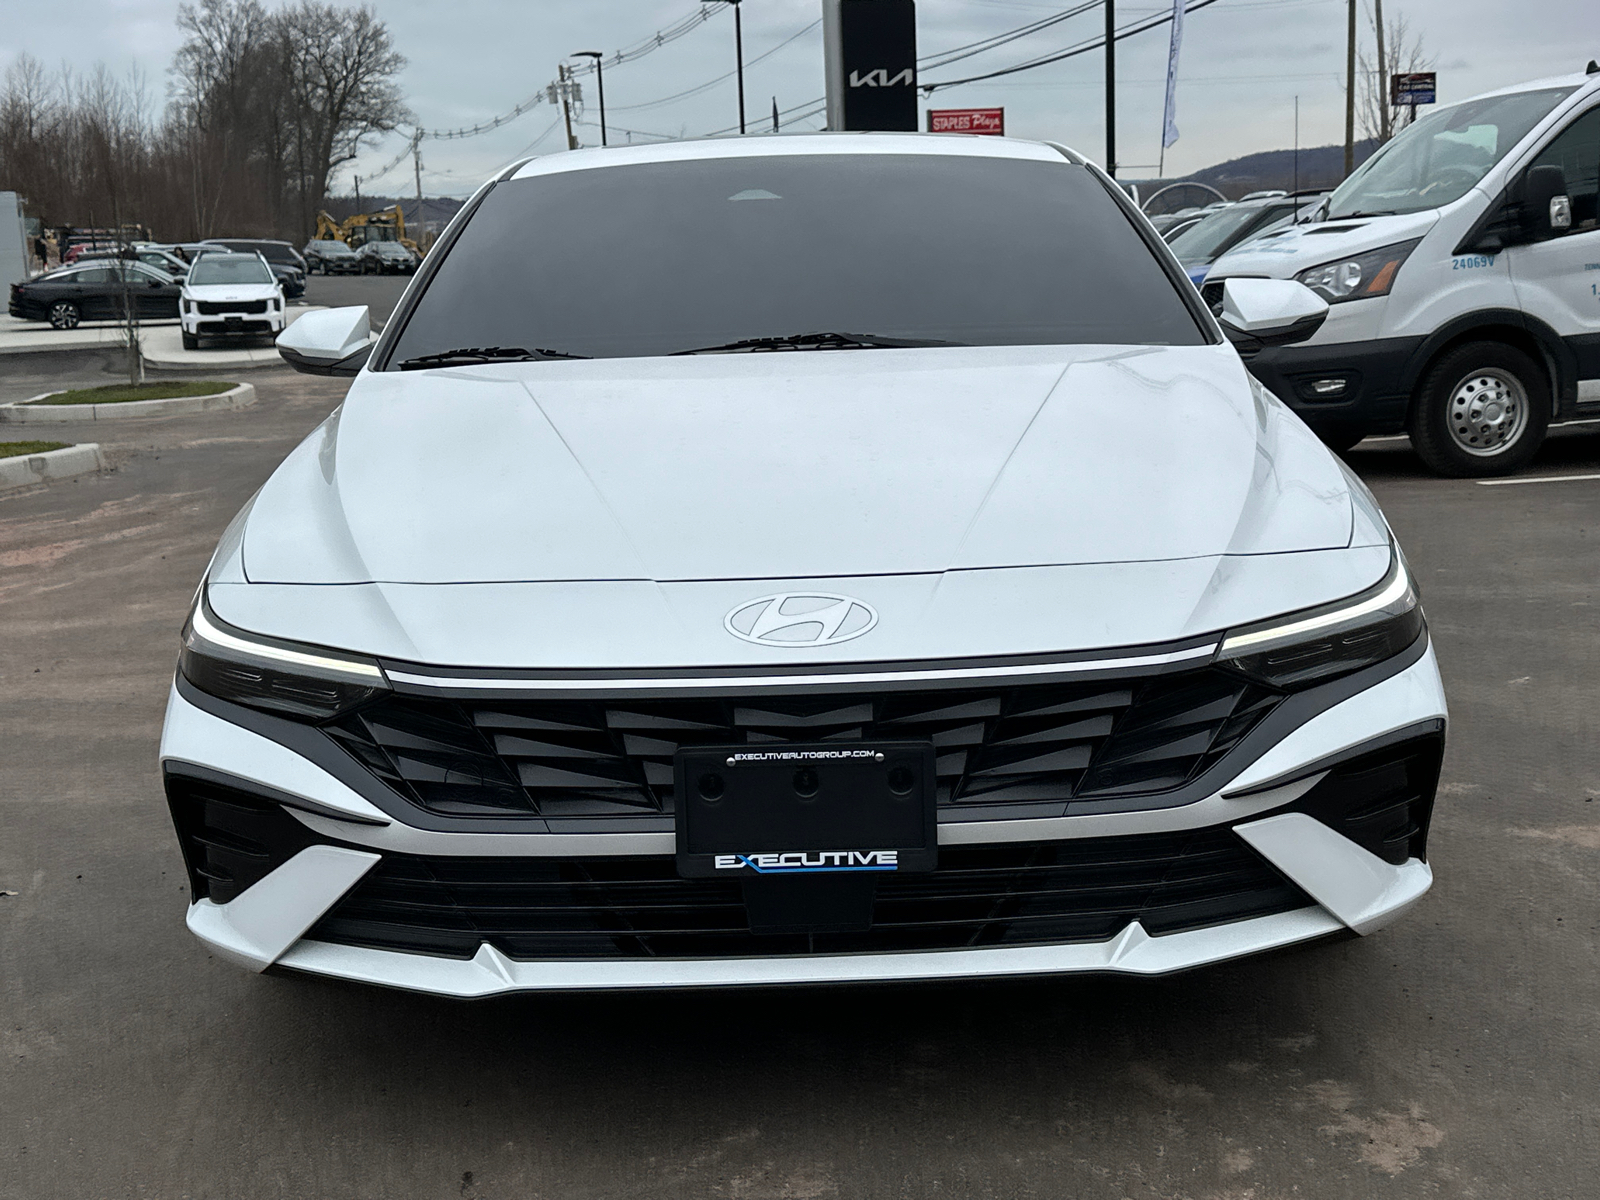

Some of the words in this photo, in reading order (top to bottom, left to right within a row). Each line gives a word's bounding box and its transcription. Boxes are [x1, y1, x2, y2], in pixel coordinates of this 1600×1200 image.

[850, 69, 912, 87] KIA
[932, 116, 970, 131] STAPLES
[1452, 255, 1495, 270] 24069V
[734, 750, 875, 761] EXECUTIVEAUTOGROUP.COM
[715, 850, 898, 870] EXECUTIVE
